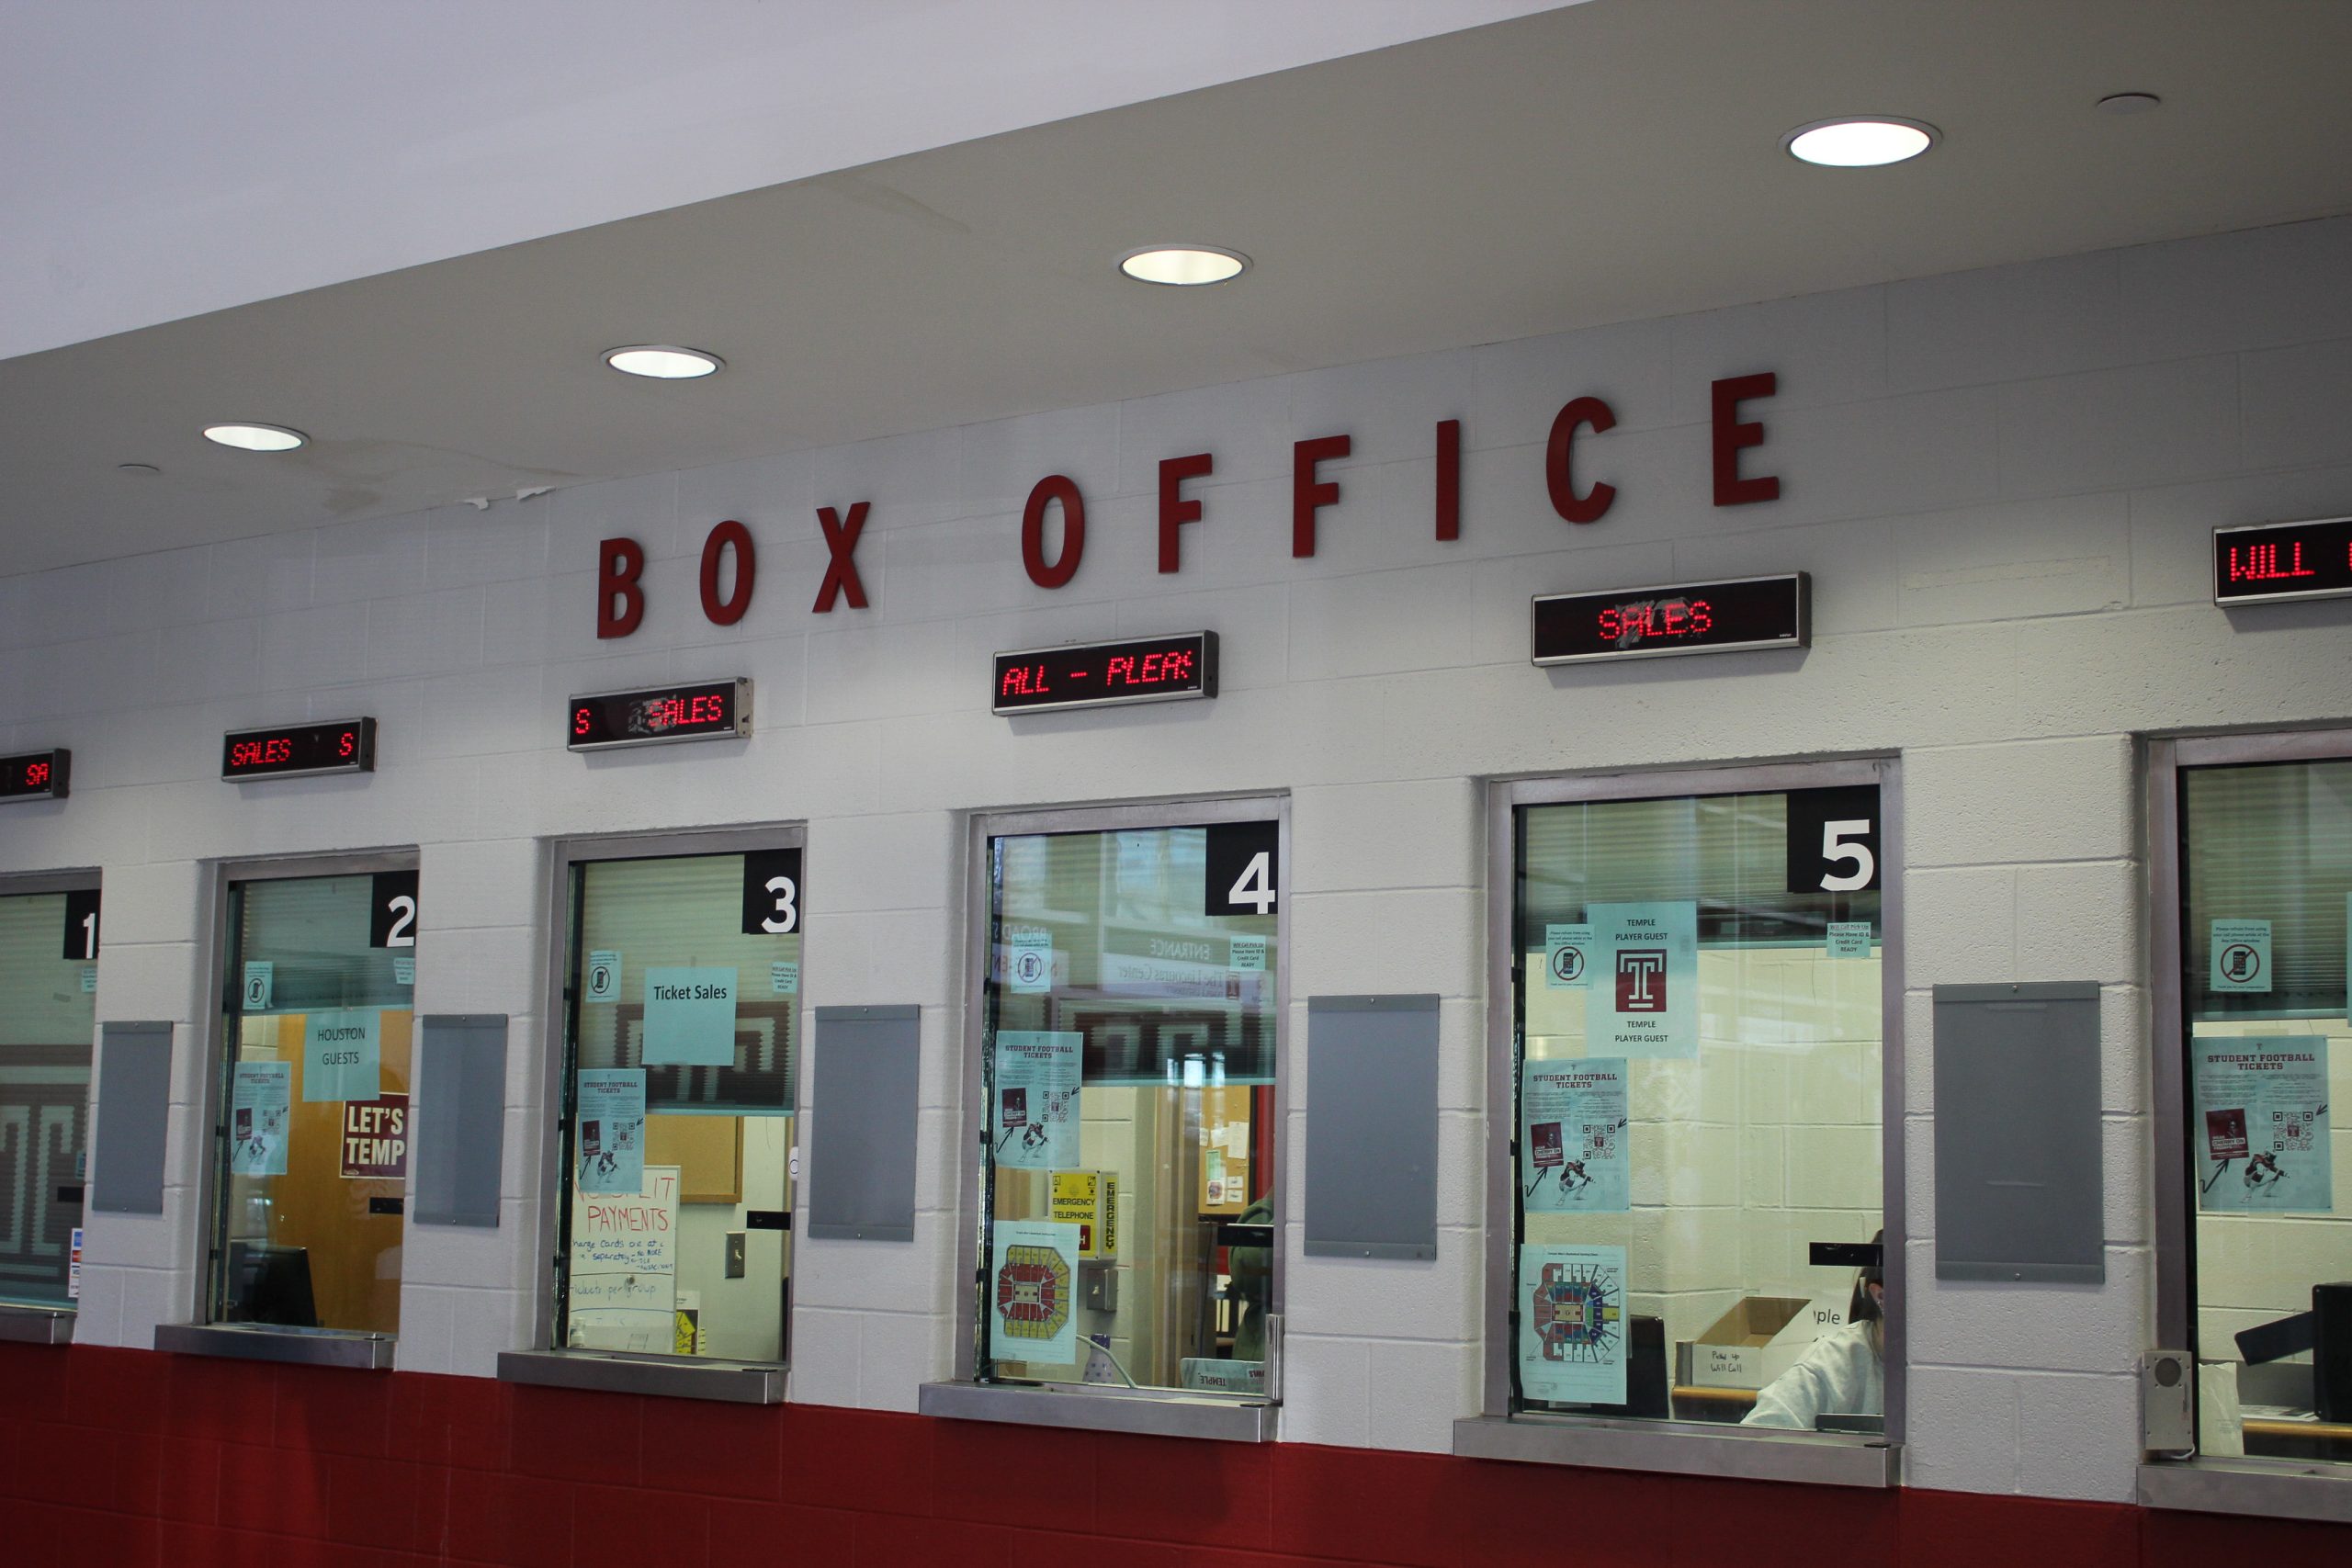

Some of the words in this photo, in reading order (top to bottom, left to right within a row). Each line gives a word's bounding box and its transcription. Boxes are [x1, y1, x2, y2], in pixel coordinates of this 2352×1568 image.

[599, 503, 868, 637] BOX
[1023, 373, 1781, 588] OFFICE
[2230, 542, 2315, 581] WILL
[1599, 600, 1713, 640] SALES
[1002, 664, 1051, 697] ALL
[575, 708, 592, 736] S
[649, 694, 724, 728] SALES
[232, 738, 292, 767] SALES
[339, 731, 354, 757] S
[1820, 818, 1874, 891] 5
[1228, 852, 1275, 915] 4
[761, 876, 797, 933] 3
[84, 913, 95, 959] 1
[387, 896, 415, 947] 2
[1626, 919, 1656, 927] TEMPLE
[654, 985, 691, 1000] Ticket
[694, 984, 727, 999] Sales
[317, 1027, 366, 1042] HOUSTON
[1614, 1034, 1643, 1043] PLAYER
[322, 1052, 359, 1066] GUESTS
[2207, 1055, 2256, 1063] STUDENT
[2259, 1054, 2315, 1062] FOOTBALL
[1532, 1074, 1571, 1082] STUDENT
[1573, 1073, 1617, 1081] FOOTBALL
[347, 1105, 404, 1135] LET'S
[587, 1204, 668, 1233] PAYMENTS
[1052, 1198, 1096, 1206] EMERGENCY
[1053, 1211, 1094, 1220] TELEPHONE
[1105, 1182, 1115, 1249] EMERGENCY
